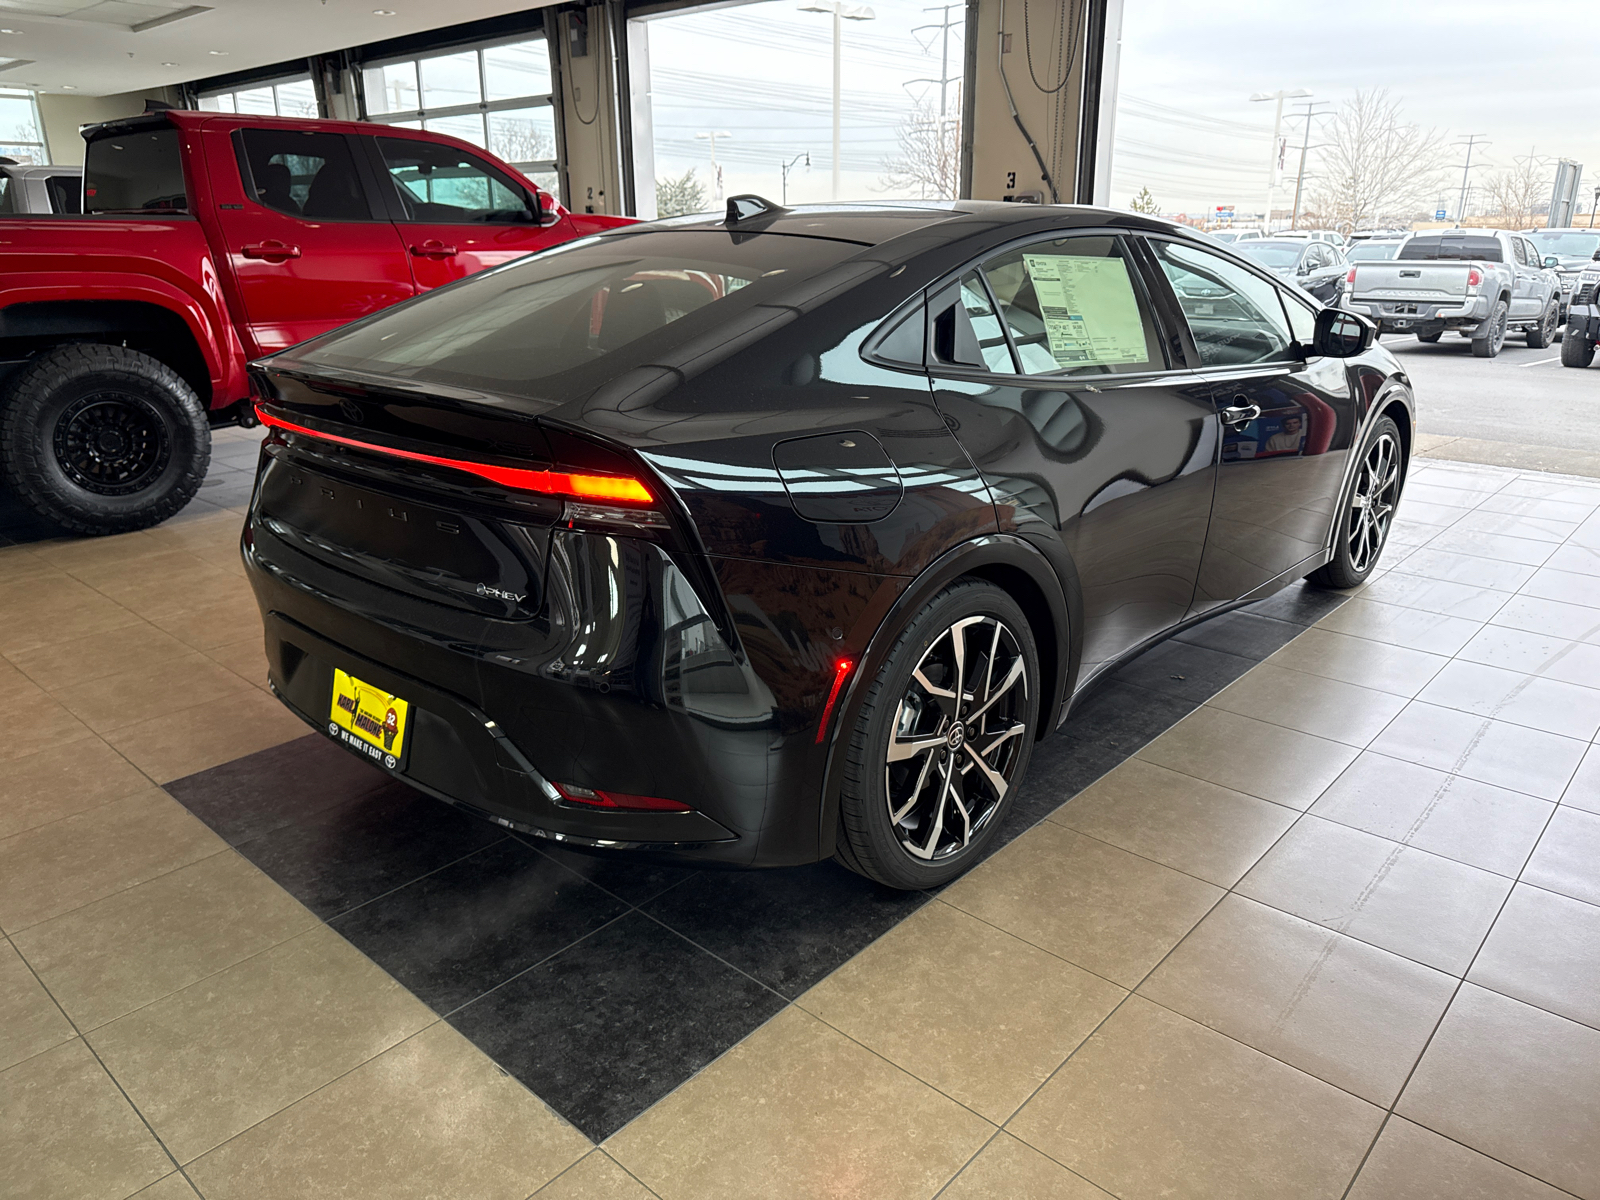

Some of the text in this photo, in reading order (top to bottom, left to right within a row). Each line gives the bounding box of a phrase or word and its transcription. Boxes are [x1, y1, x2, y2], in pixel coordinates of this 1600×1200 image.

[587, 186, 593, 200] 2
[1006, 171, 1016, 189] 3
[290, 476, 460, 535] PRIUS
[355, 713, 383, 740] MALONE
[341, 730, 382, 760] WE MAKE IT EASY
